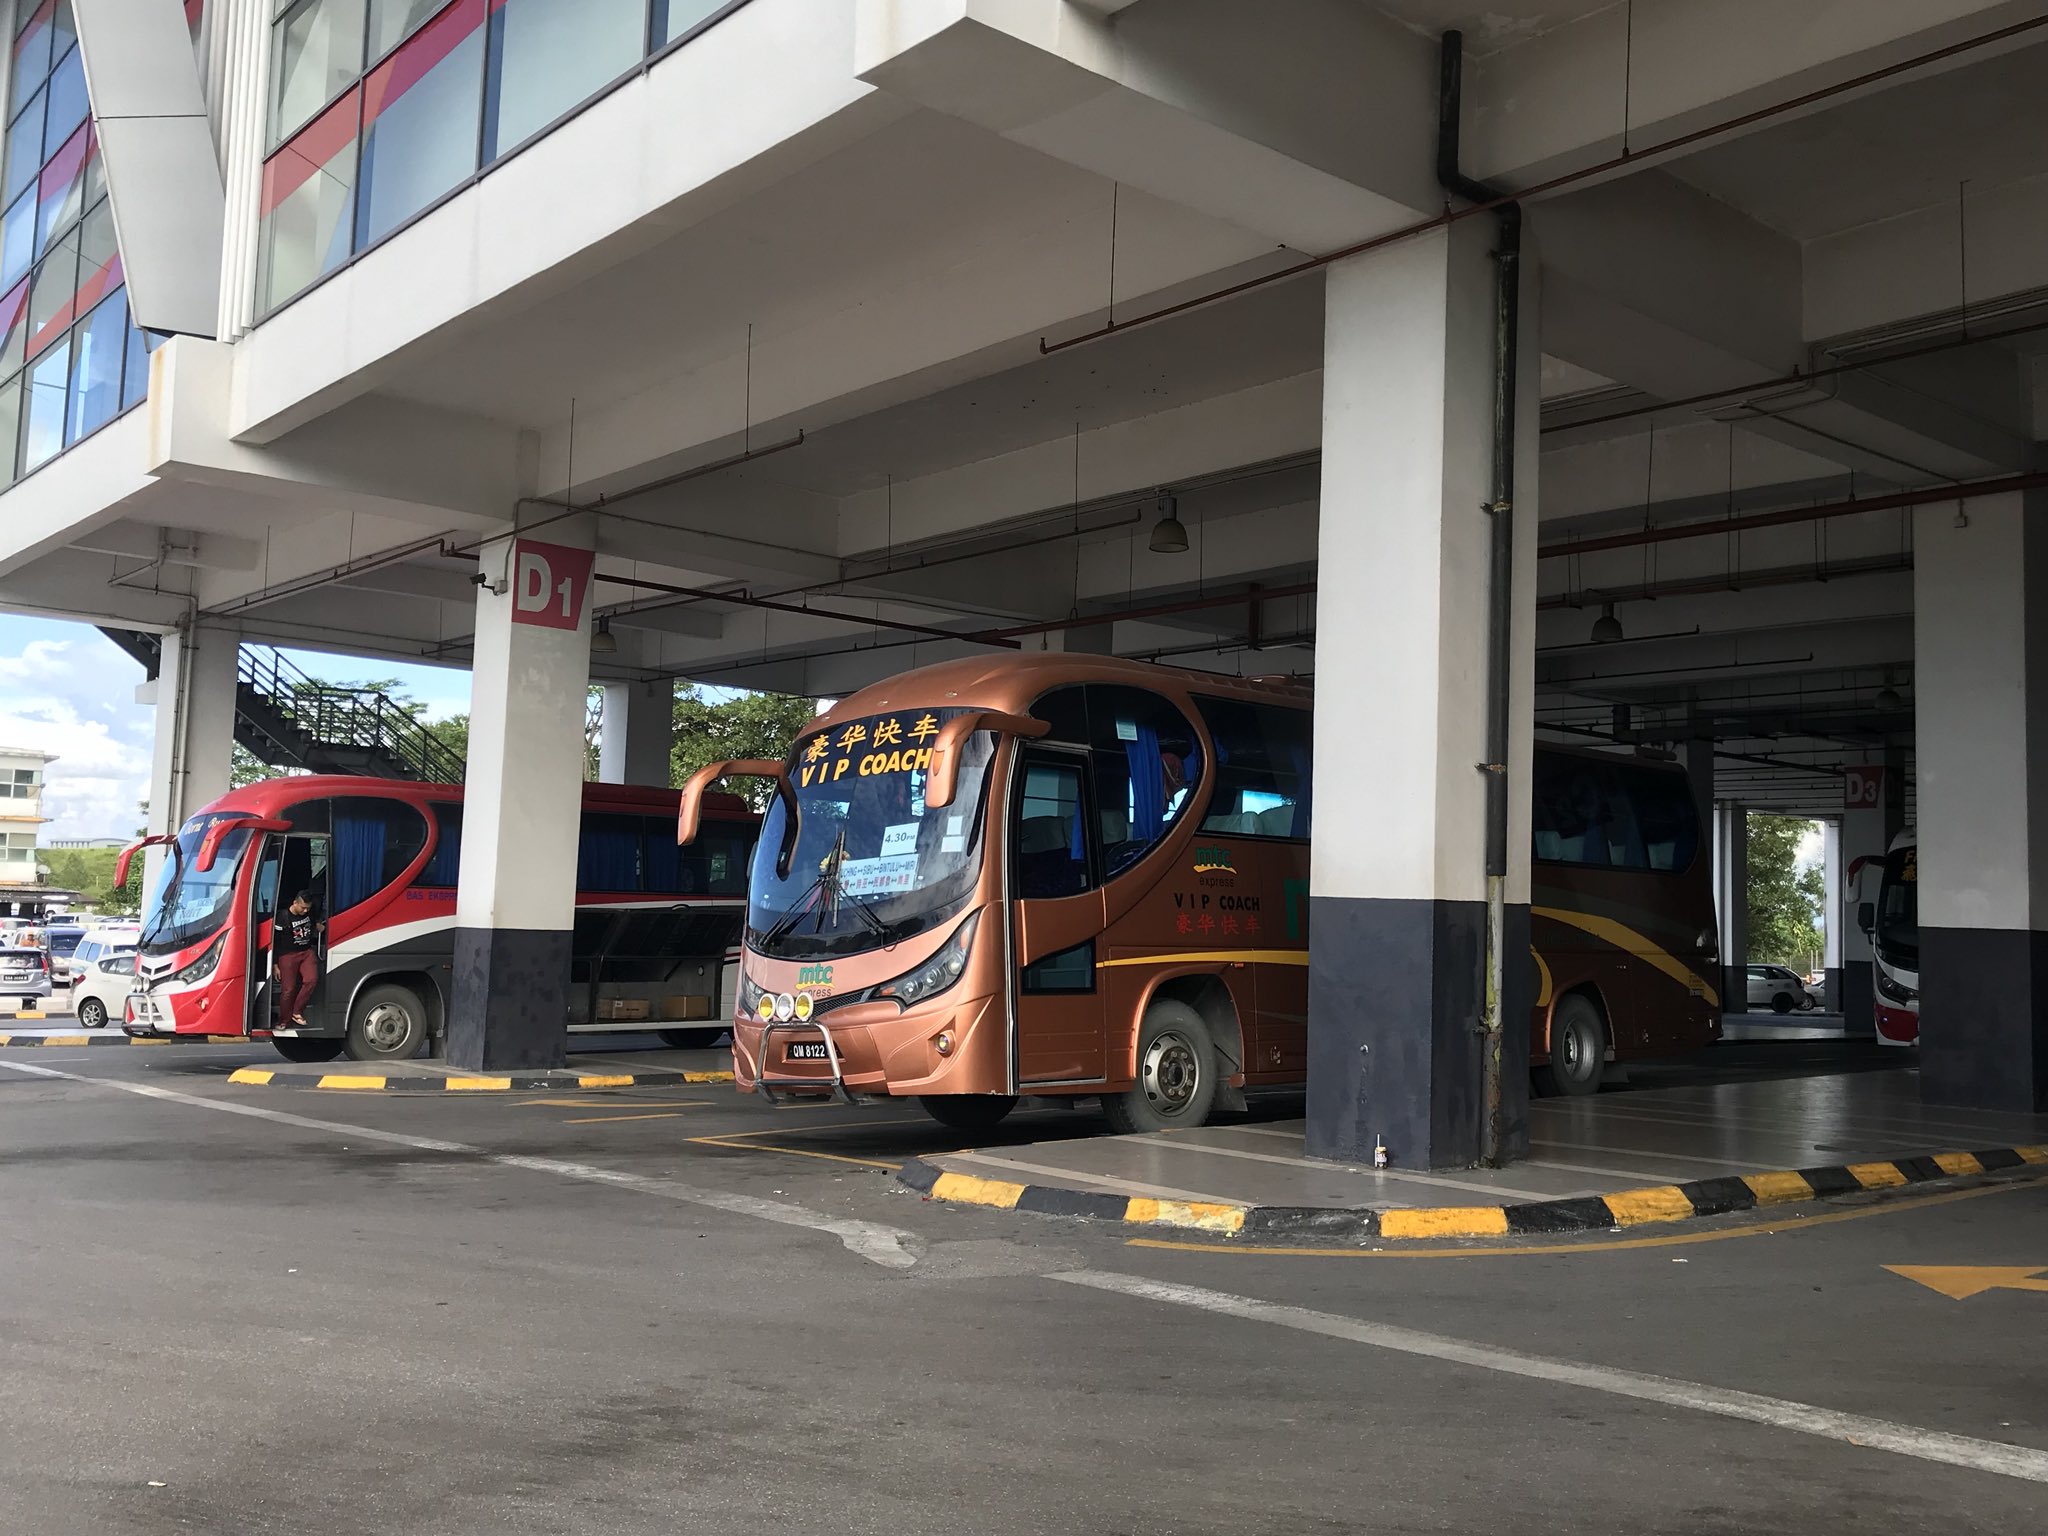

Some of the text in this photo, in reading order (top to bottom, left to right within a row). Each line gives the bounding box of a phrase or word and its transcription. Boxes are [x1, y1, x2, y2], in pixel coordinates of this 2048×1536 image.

[517, 552, 572, 617] D1
[804, 713, 940, 763] 豪华快车
[858, 748, 933, 777] COACH
[1846, 773, 1877, 802] D3
[1195, 845, 1233, 867] mtc
[1199, 876, 1235, 889] express
[1219, 895, 1260, 911] COACH
[799, 962, 833, 984] mtc
[793, 1044, 825, 1057] QM 8122
